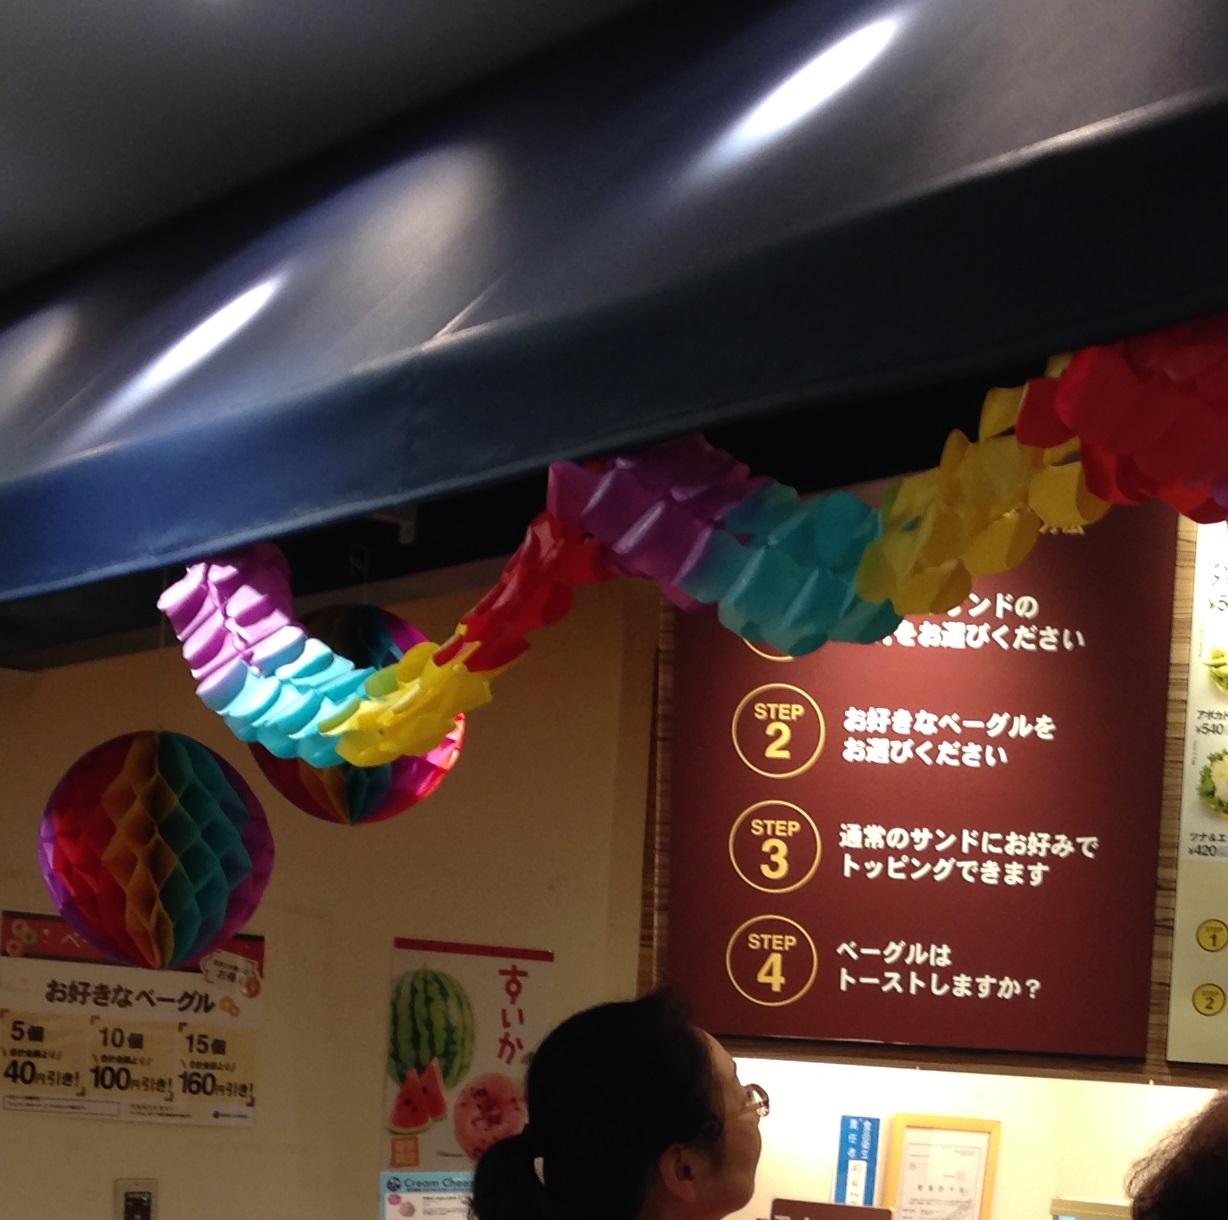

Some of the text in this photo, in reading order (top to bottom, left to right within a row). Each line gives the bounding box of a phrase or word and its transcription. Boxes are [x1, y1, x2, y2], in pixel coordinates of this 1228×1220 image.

[880, 619, 1086, 651] をお選びください
[753, 702, 804, 721] STEP
[842, 707, 1057, 741] お好きなベーグルを
[764, 722, 791, 760] 2
[841, 737, 1008, 767] お選びください
[750, 819, 801, 838] STEP
[839, 823, 1099, 859] 通常のサンドにお好みで
[759, 839, 789, 880] 3
[841, 853, 1050, 887] トッピングできます
[747, 932, 797, 951] STEP
[836, 940, 952, 967] ベーグルは
[756, 952, 785, 992] 4
[45, 979, 217, 1014] お好きなベーグル
[1204, 997, 1215, 1011] 2
[497, 965, 529, 1065] すいか
[404, 1178, 440, 1188] Cream
